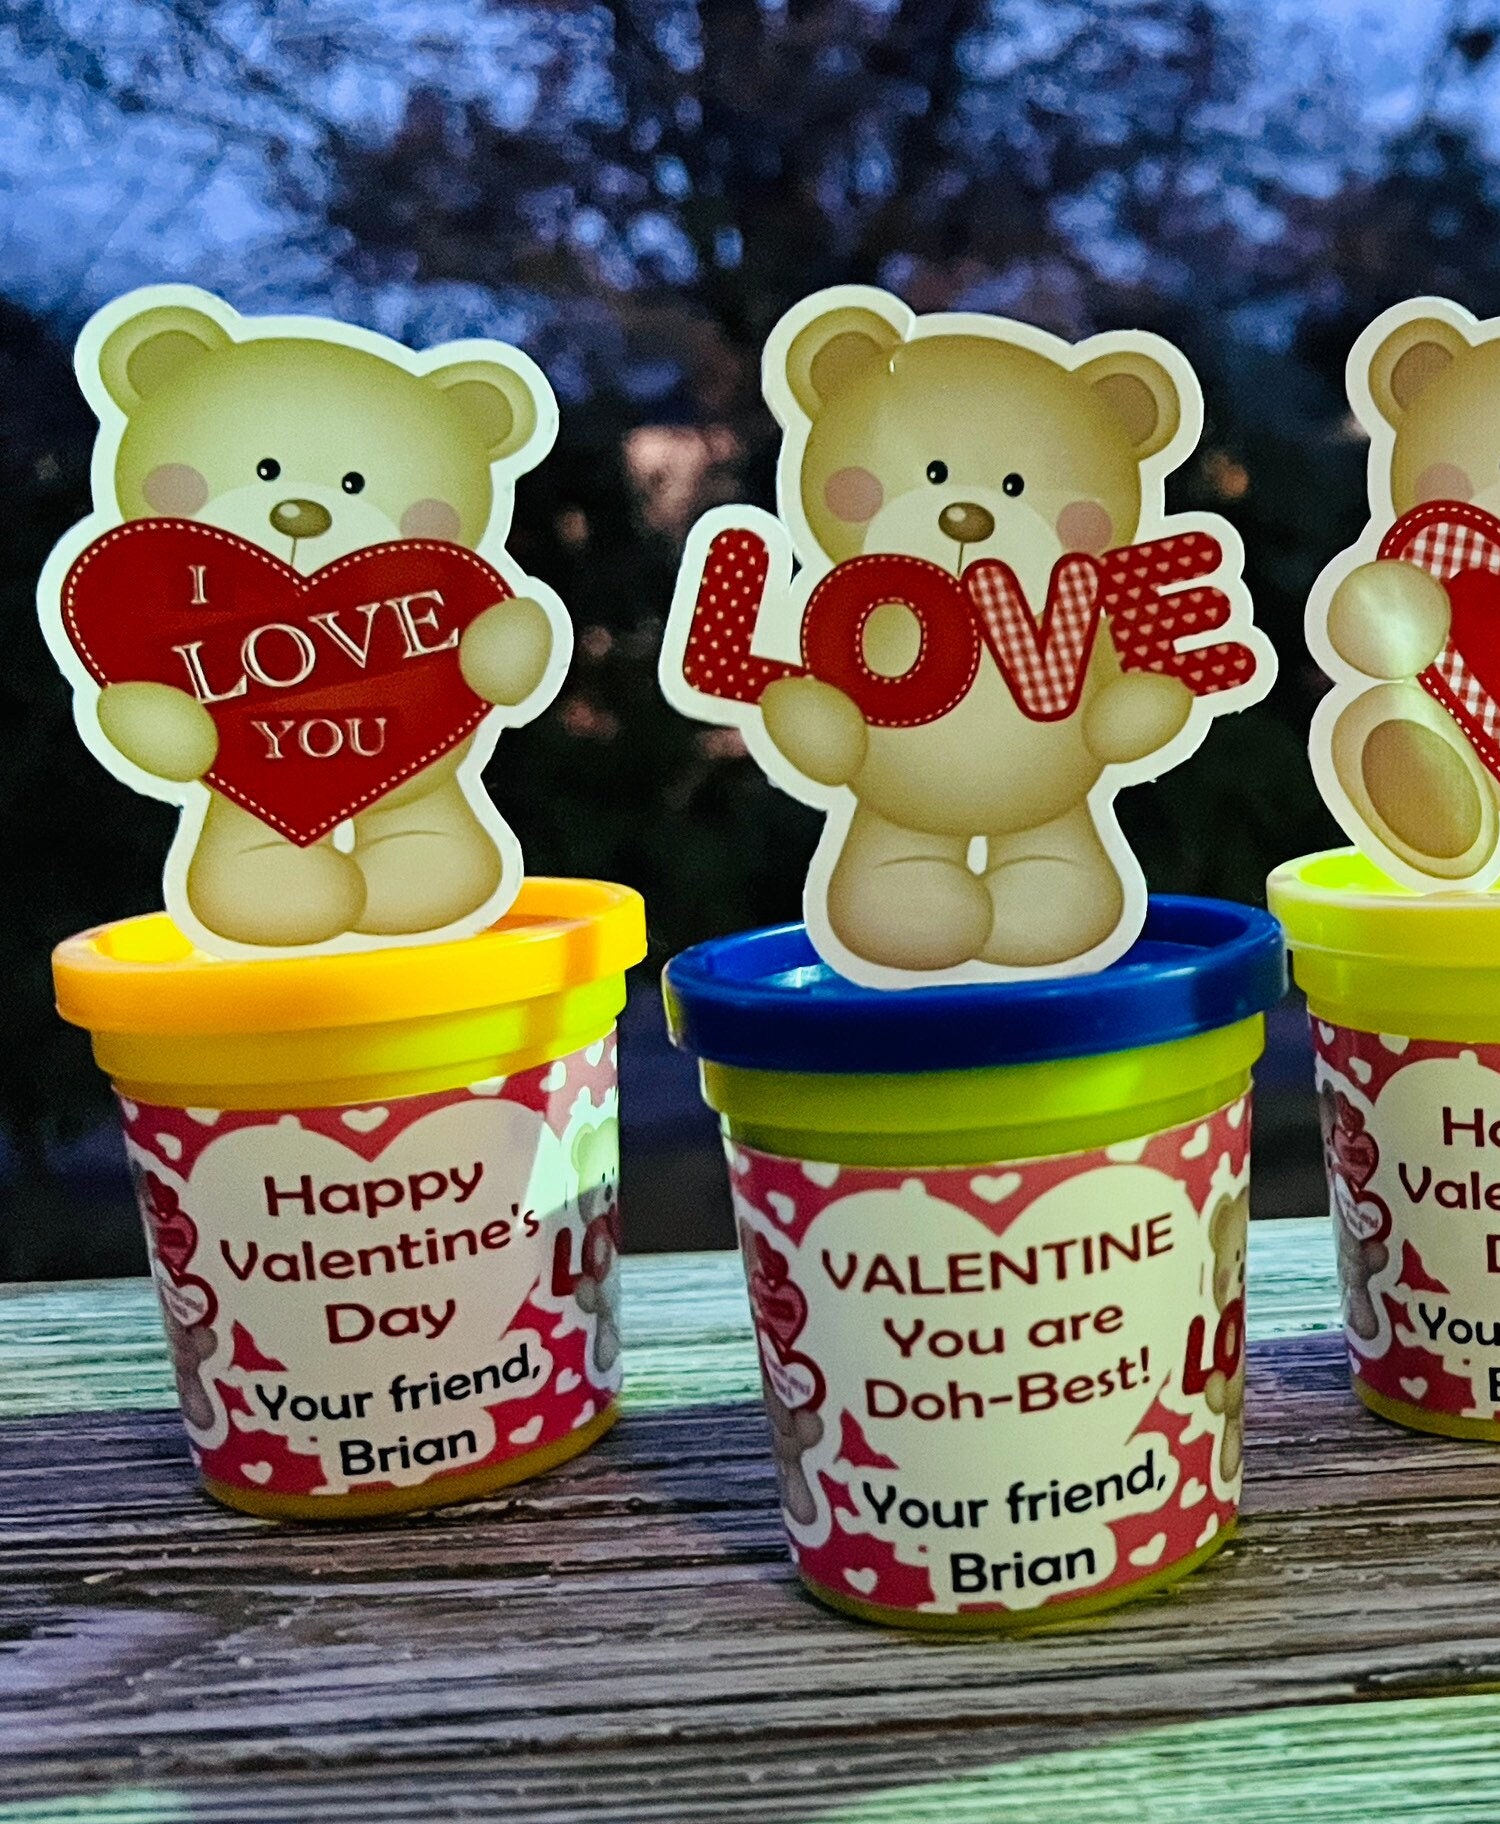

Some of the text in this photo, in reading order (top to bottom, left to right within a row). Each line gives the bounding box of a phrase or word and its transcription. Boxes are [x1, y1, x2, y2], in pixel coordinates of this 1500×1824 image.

[189, 565, 209, 604] I
[173, 589, 460, 704] LOVE
[683, 527, 1257, 728] LOVE
[251, 717, 387, 759] YOU
[264, 1162, 483, 1218] Happy
[220, 1204, 540, 1282] Valentine's
[821, 1213, 1174, 1295] VALENTINE
[326, 1299, 455, 1344] Day
[884, 1305, 1123, 1358] You are
[255, 1344, 541, 1422] Your friend,
[865, 1347, 1151, 1420] Doh-Best!
[339, 1429, 477, 1476] Brian
[862, 1450, 1167, 1528] Your friend,
[949, 1548, 1095, 1593] Brian
